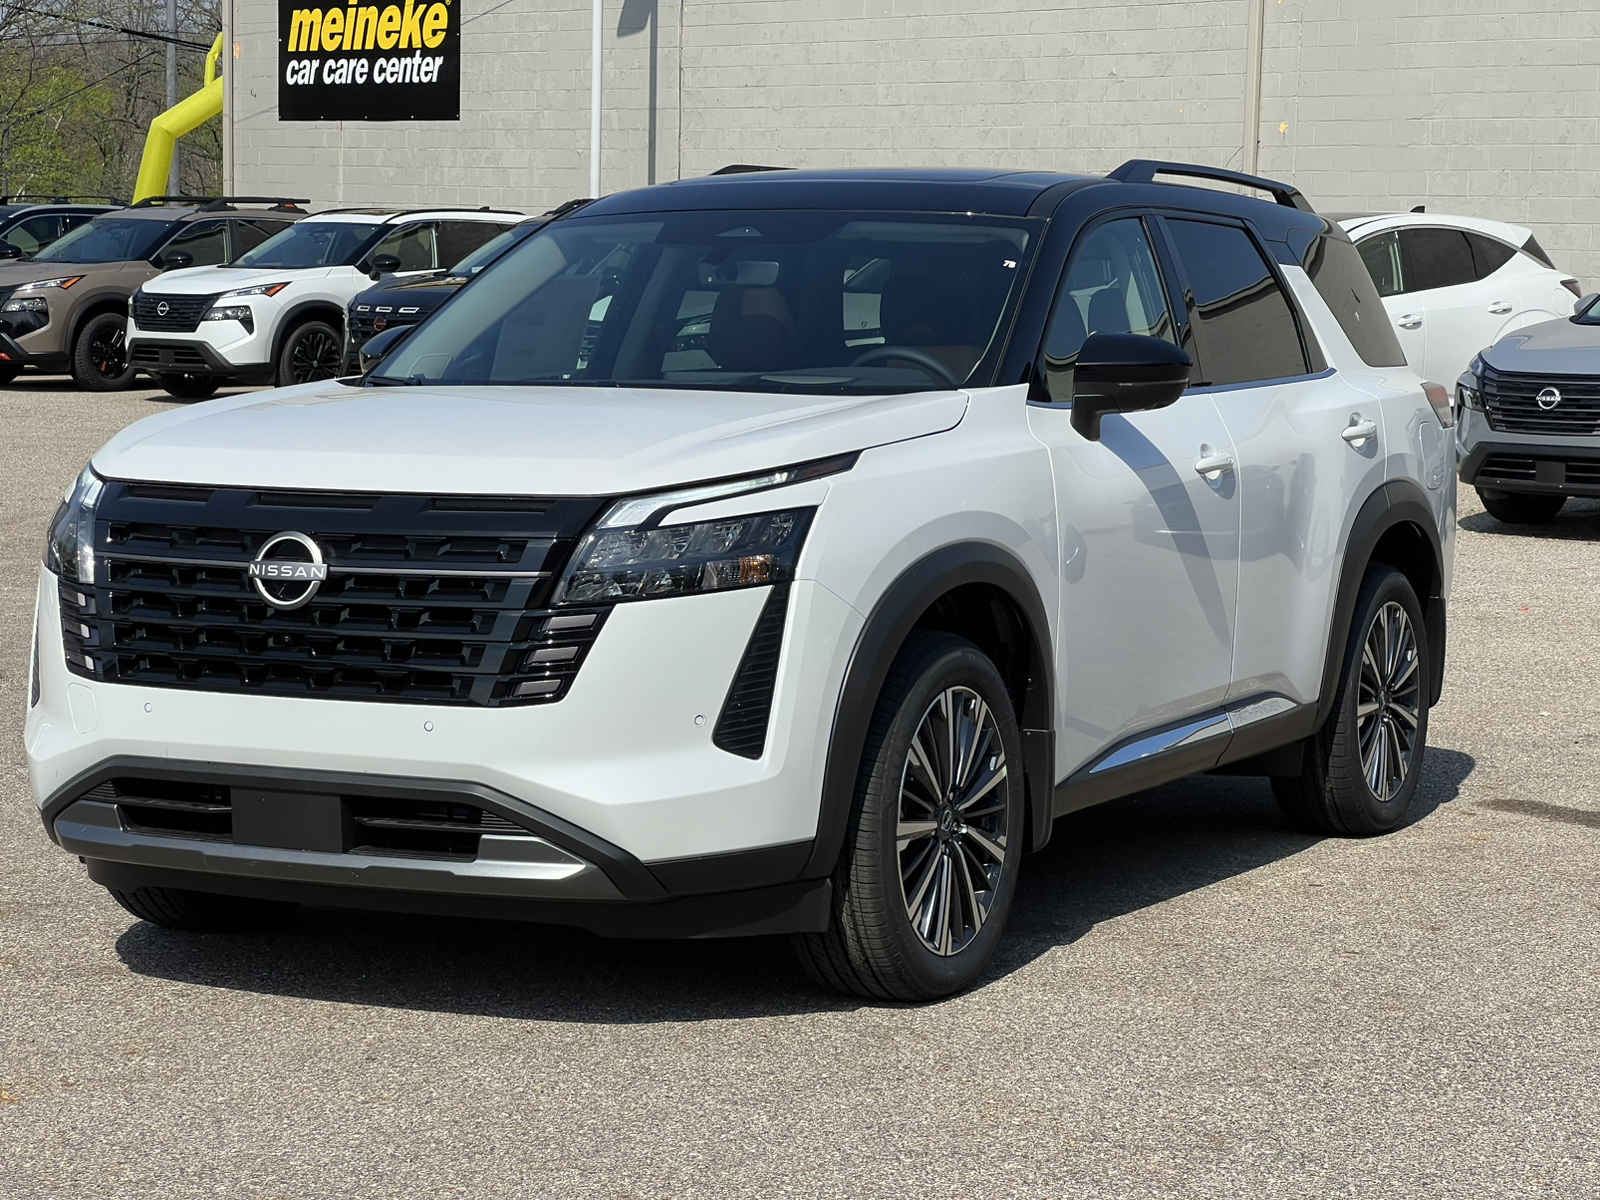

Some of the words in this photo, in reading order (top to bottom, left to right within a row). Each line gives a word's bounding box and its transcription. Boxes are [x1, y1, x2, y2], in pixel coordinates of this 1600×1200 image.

[288, 0, 448, 52] meineke
[286, 58, 320, 85] car
[322, 57, 369, 85] care
[373, 50, 444, 84] center
[249, 563, 325, 578] NISSAN
